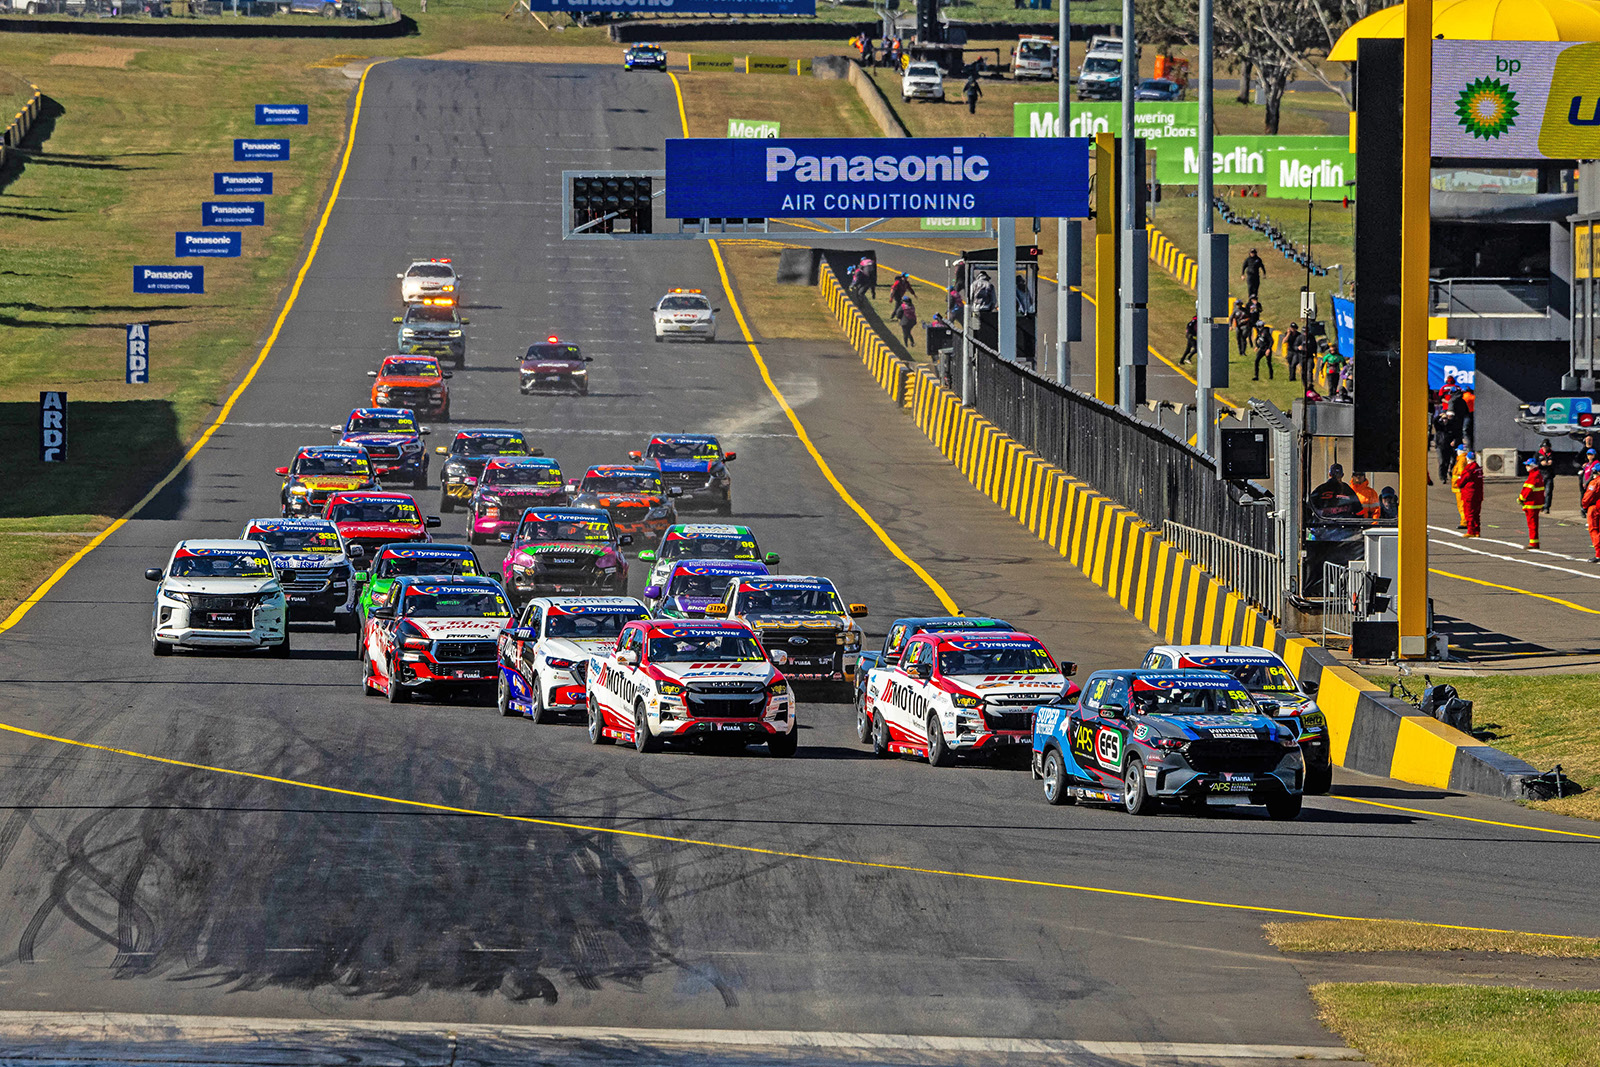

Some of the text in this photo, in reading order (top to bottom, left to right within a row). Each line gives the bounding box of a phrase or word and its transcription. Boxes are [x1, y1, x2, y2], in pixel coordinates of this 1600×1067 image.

[1496, 55, 1521, 76] bp
[263, 107, 300, 115] Panasonic
[1134, 110, 1175, 126] wering
[730, 121, 778, 138] Merlin
[1134, 126, 1196, 140] rage Doors
[242, 142, 281, 150] Panasonic
[766, 146, 990, 182] Panasonic
[1280, 159, 1344, 188] Merlin
[222, 176, 264, 184] Panasonic
[781, 194, 976, 210] AIR CONDITIONING
[211, 206, 255, 214] Panasonic
[186, 236, 231, 244] Panasonic
[144, 270, 193, 279] Panasonic
[128, 324, 147, 384] ARDC
[586, 522, 609, 531] 777
[318, 532, 338, 540] 333
[254, 557, 269, 565] 90
[827, 591, 835, 599] 7
[495, 596, 504, 604] 8
[749, 638, 757, 646] 1
[1031, 649, 1048, 658] 15
[1269, 667, 1287, 676] 64
[1175, 680, 1229, 688] Tyrepower
[1228, 690, 1247, 700] 58
[1037, 708, 1060, 724] SUPER
[1076, 725, 1093, 753] APS
[1100, 733, 1119, 760] EFS
[1211, 782, 1231, 792] APS
